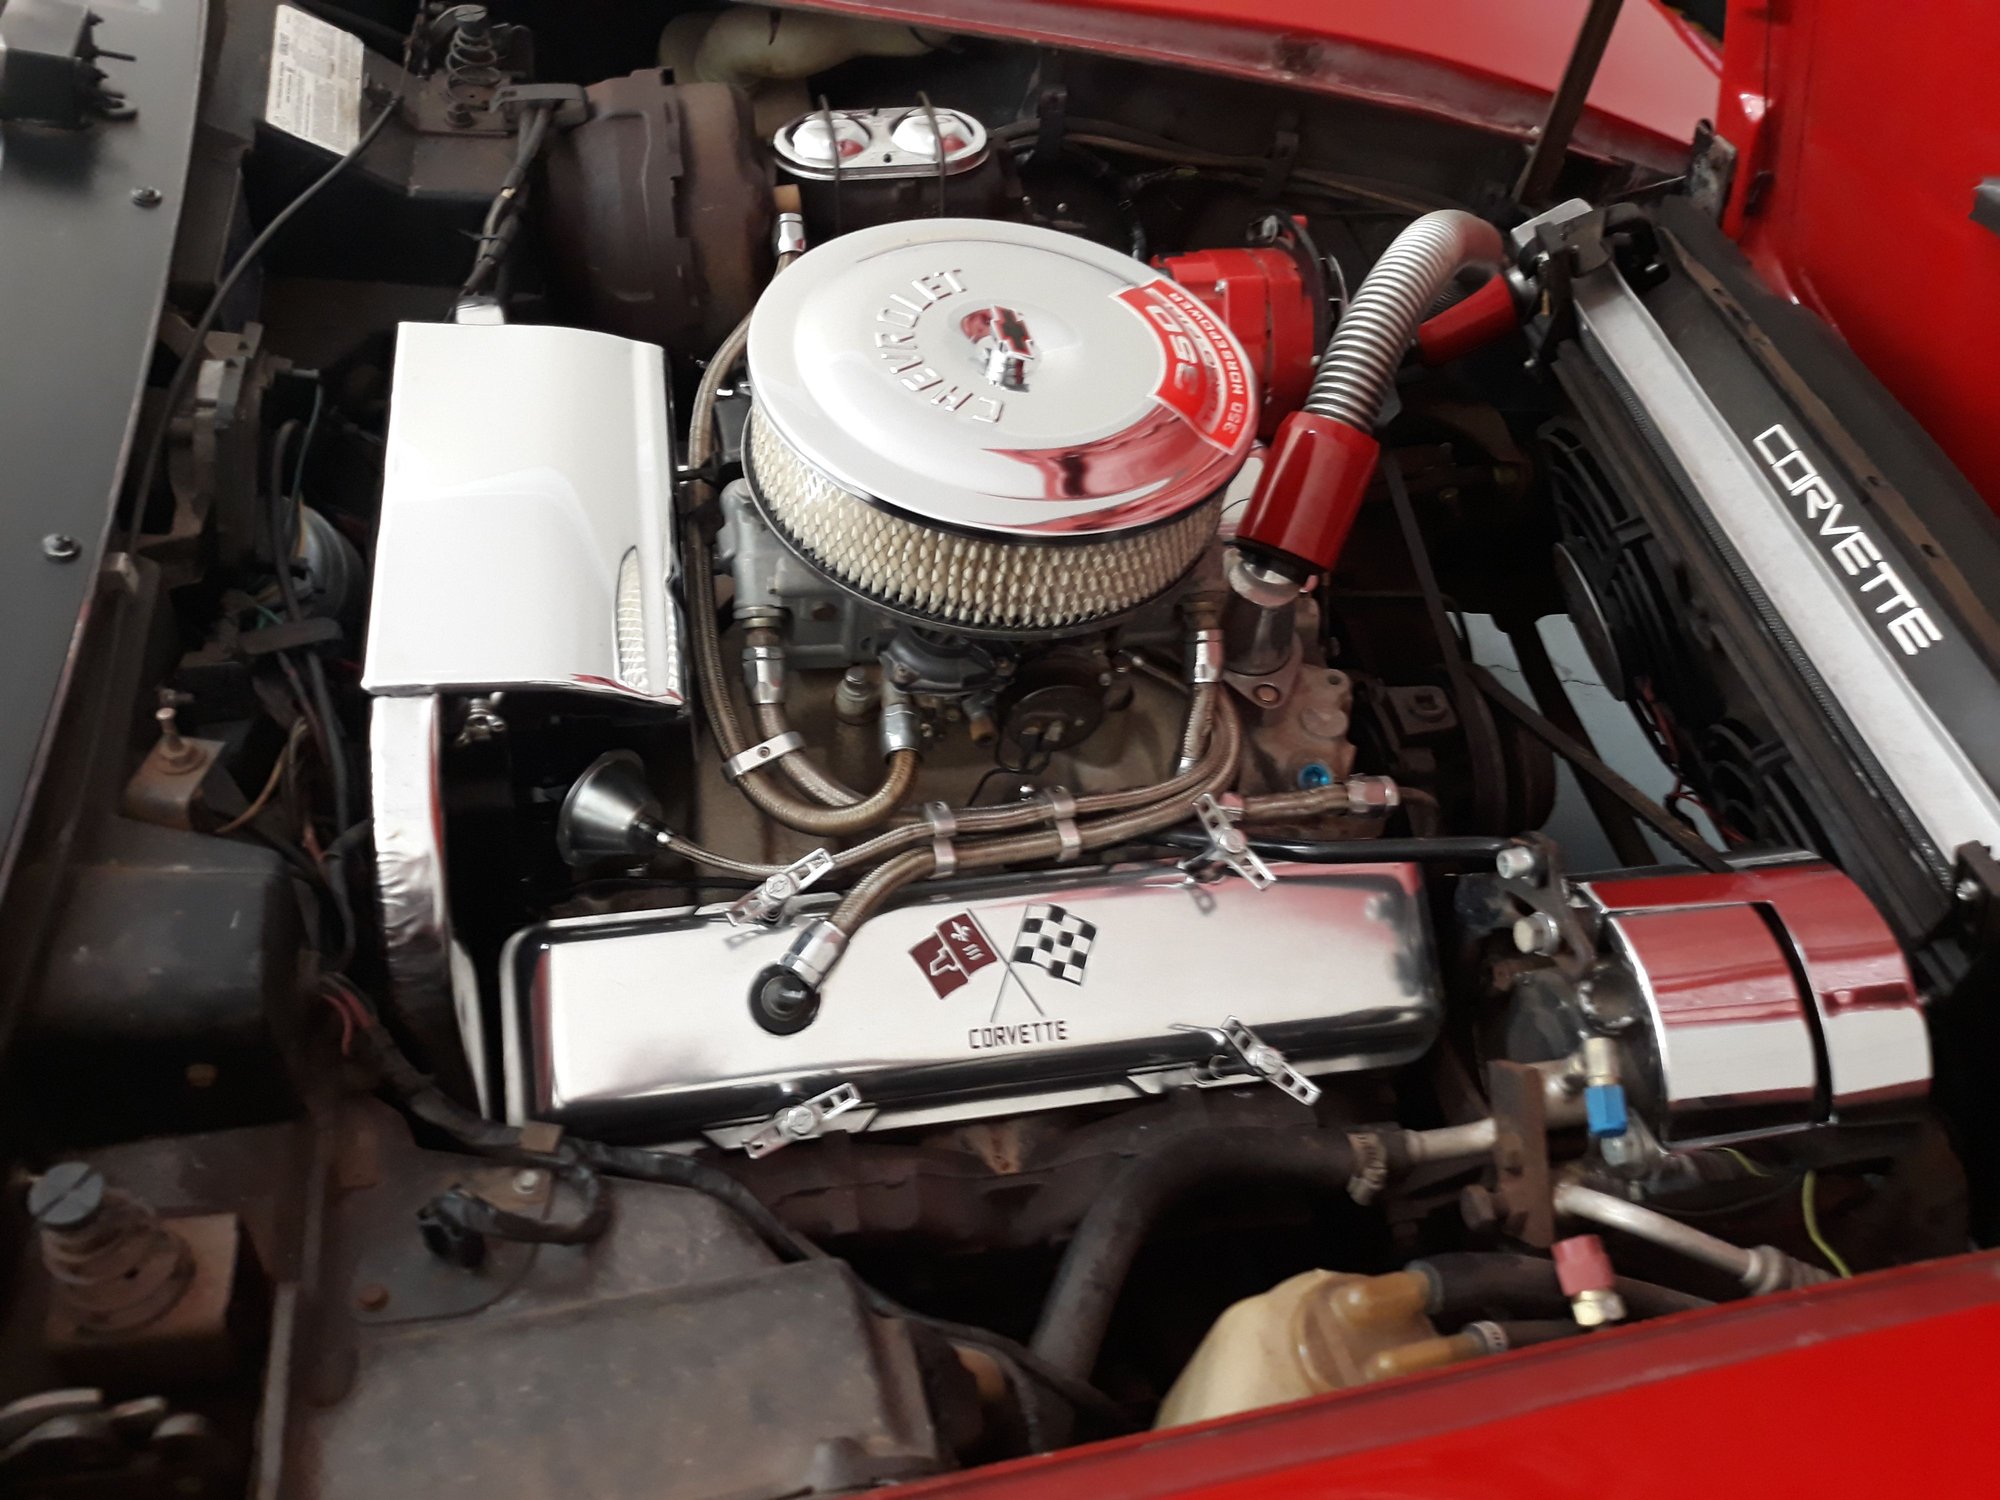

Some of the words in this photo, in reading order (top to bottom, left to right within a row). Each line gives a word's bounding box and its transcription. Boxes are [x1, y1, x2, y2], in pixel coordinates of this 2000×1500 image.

[874, 268, 1006, 424] CHEVROLET
[1145, 304, 1199, 396] 350
[1168, 291, 1244, 395] HORSEPOWER
[1221, 401, 1244, 434] 350
[1752, 423, 1944, 656] CORVETTE
[968, 1020, 1068, 1049] CORVETTE
